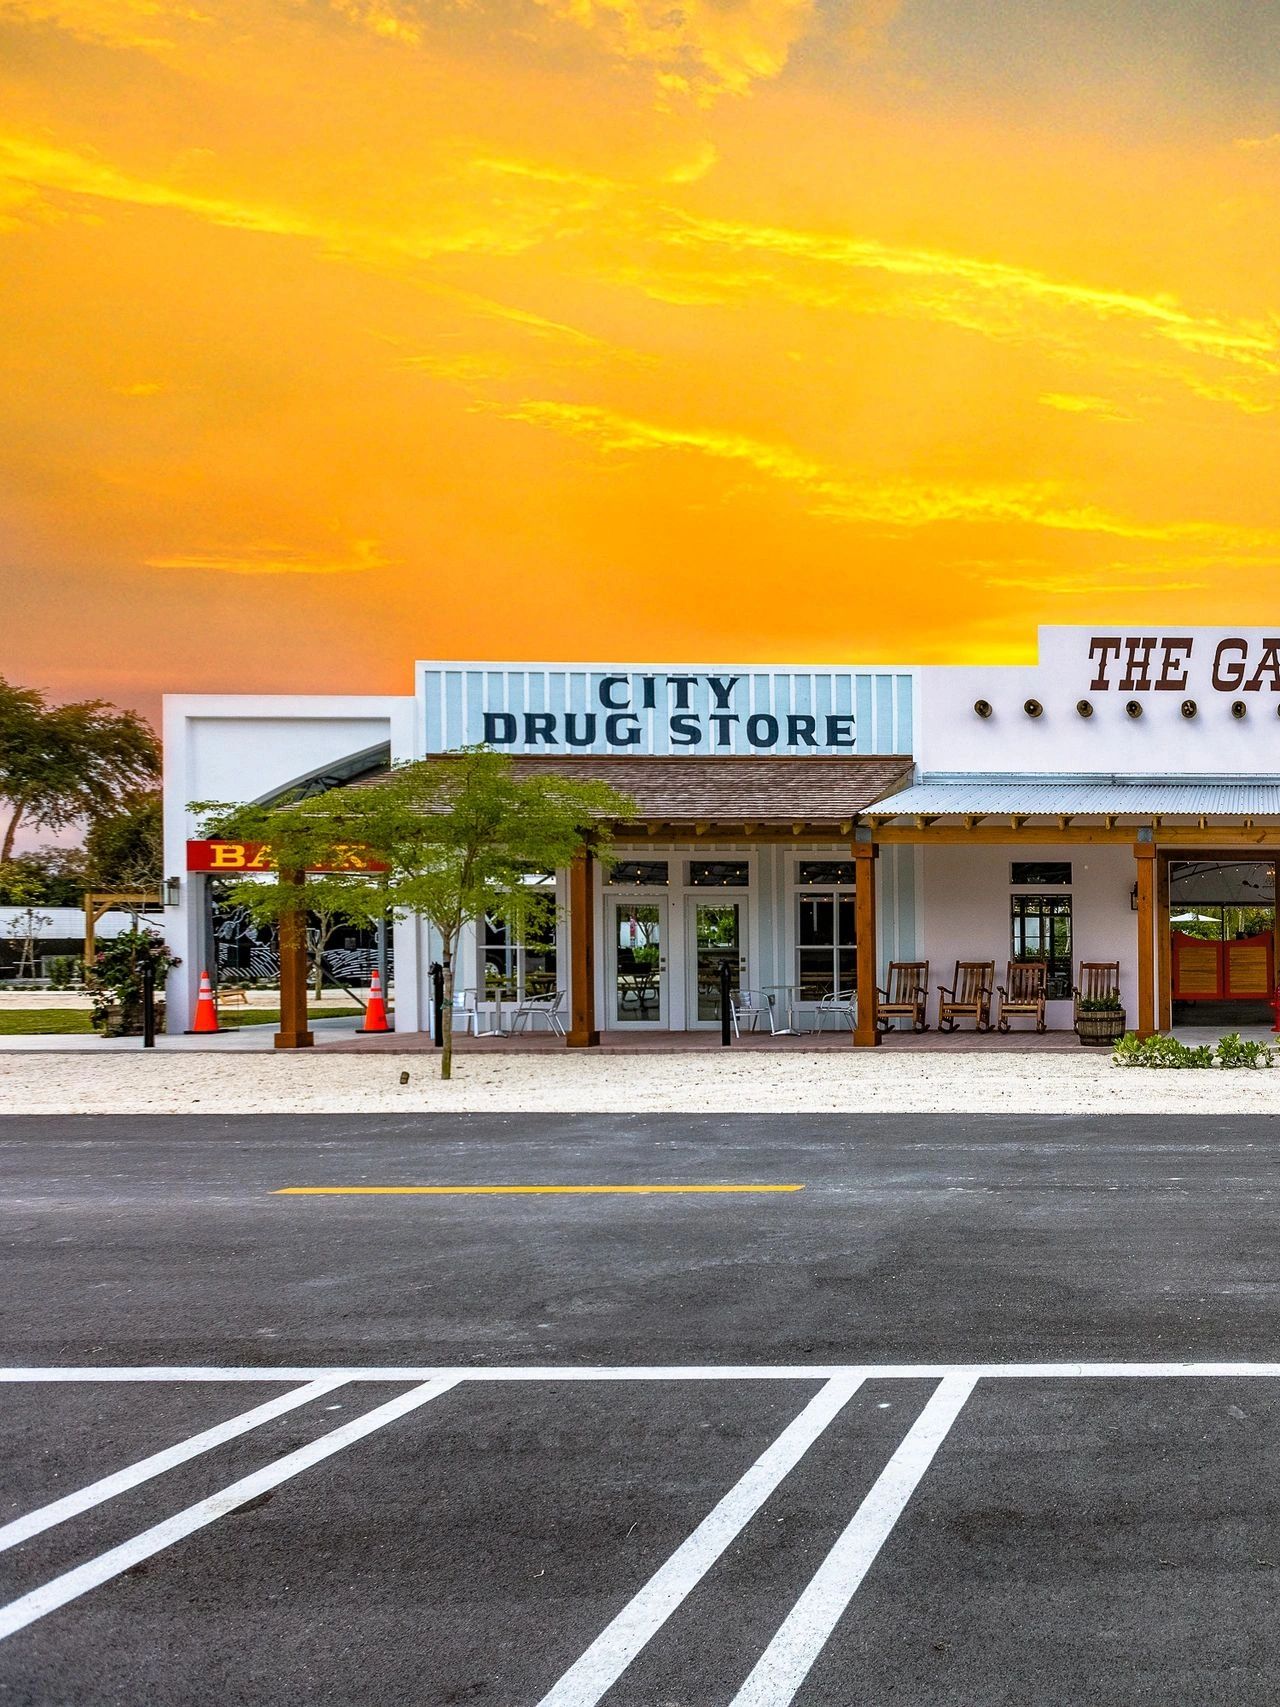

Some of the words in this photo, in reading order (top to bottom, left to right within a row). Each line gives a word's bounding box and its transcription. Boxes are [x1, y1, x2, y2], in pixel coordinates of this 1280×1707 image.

[1088, 637, 1193, 691] THE
[599, 676, 740, 709] CITY
[482, 712, 642, 746] DRUG
[669, 713, 857, 747] STORE
[210, 844, 368, 868] BAK
